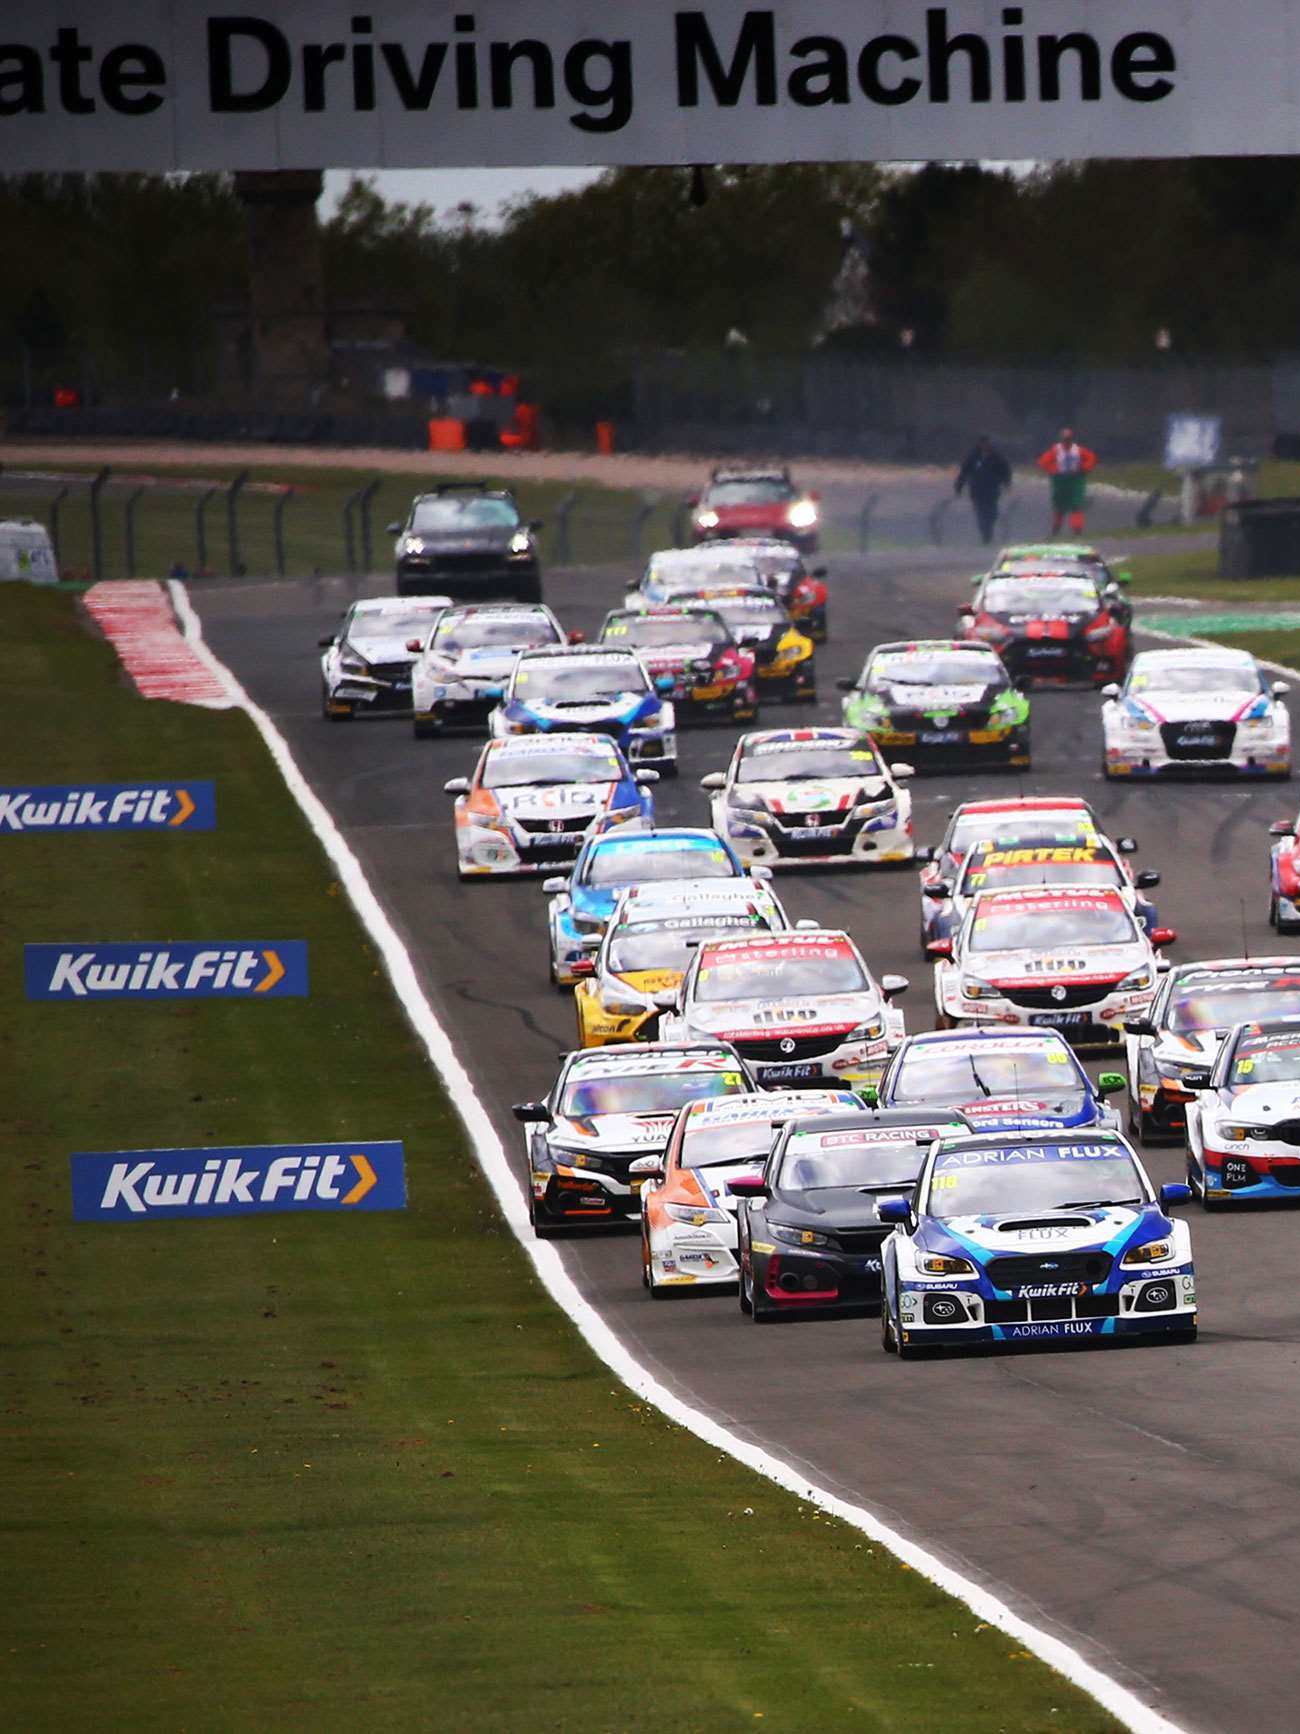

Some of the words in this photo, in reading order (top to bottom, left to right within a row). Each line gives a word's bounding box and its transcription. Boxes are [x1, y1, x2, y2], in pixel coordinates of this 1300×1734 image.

[206, 14, 632, 132] Driving
[675, 8, 1177, 107] Machine
[983, 848, 1096, 868] PIRTEK
[1236, 1059, 1254, 1074] 15
[1002, 1117, 1064, 1128] Sensors
[865, 1130, 930, 1141] RACING
[942, 1147, 1045, 1167] ADRIAN
[1057, 1145, 1122, 1159] FLUX
[1226, 1162, 1247, 1173] ONE
[1152, 1268, 1181, 1277] SUBARU
[1012, 1324, 1059, 1337] ADRIAN
[1063, 1322, 1093, 1335] FLUX
